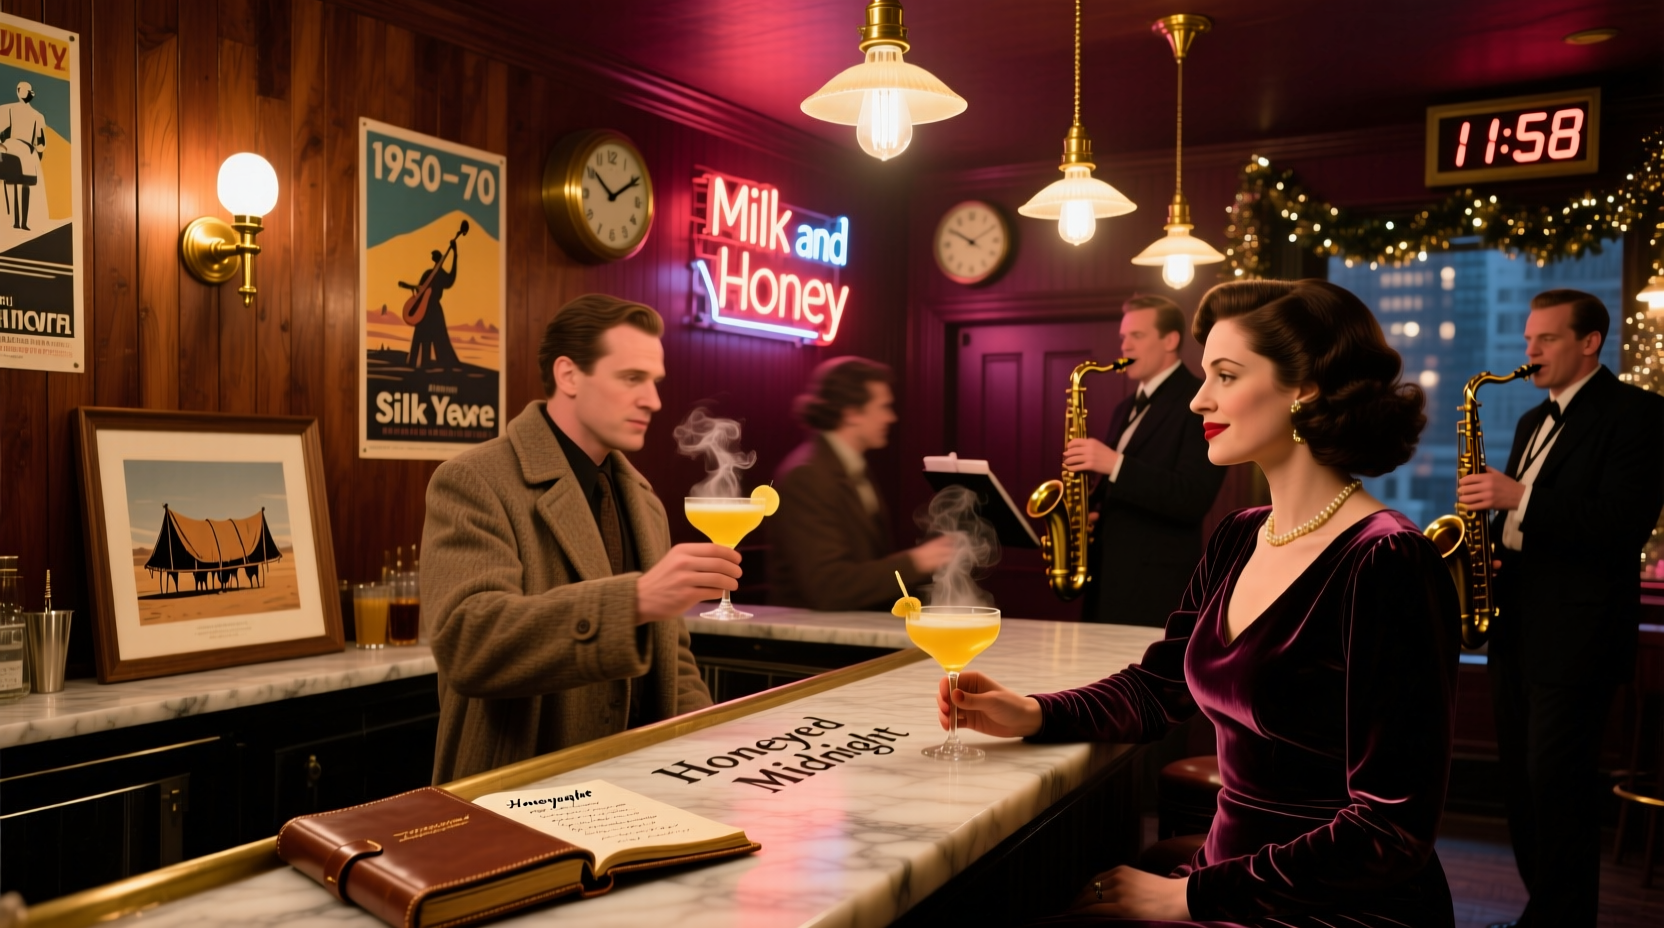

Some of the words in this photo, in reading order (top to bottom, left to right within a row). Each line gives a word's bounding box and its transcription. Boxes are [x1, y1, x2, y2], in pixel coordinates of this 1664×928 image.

[1455, 108, 1585, 168] 11:58
[712, 176, 792, 254] Milk
[795, 216, 849, 267] and
[718, 245, 850, 342] Honey
[375, 391, 428, 425] Silk
[651, 716, 845, 785] Honeyed
[731, 726, 910, 794] Midnight
